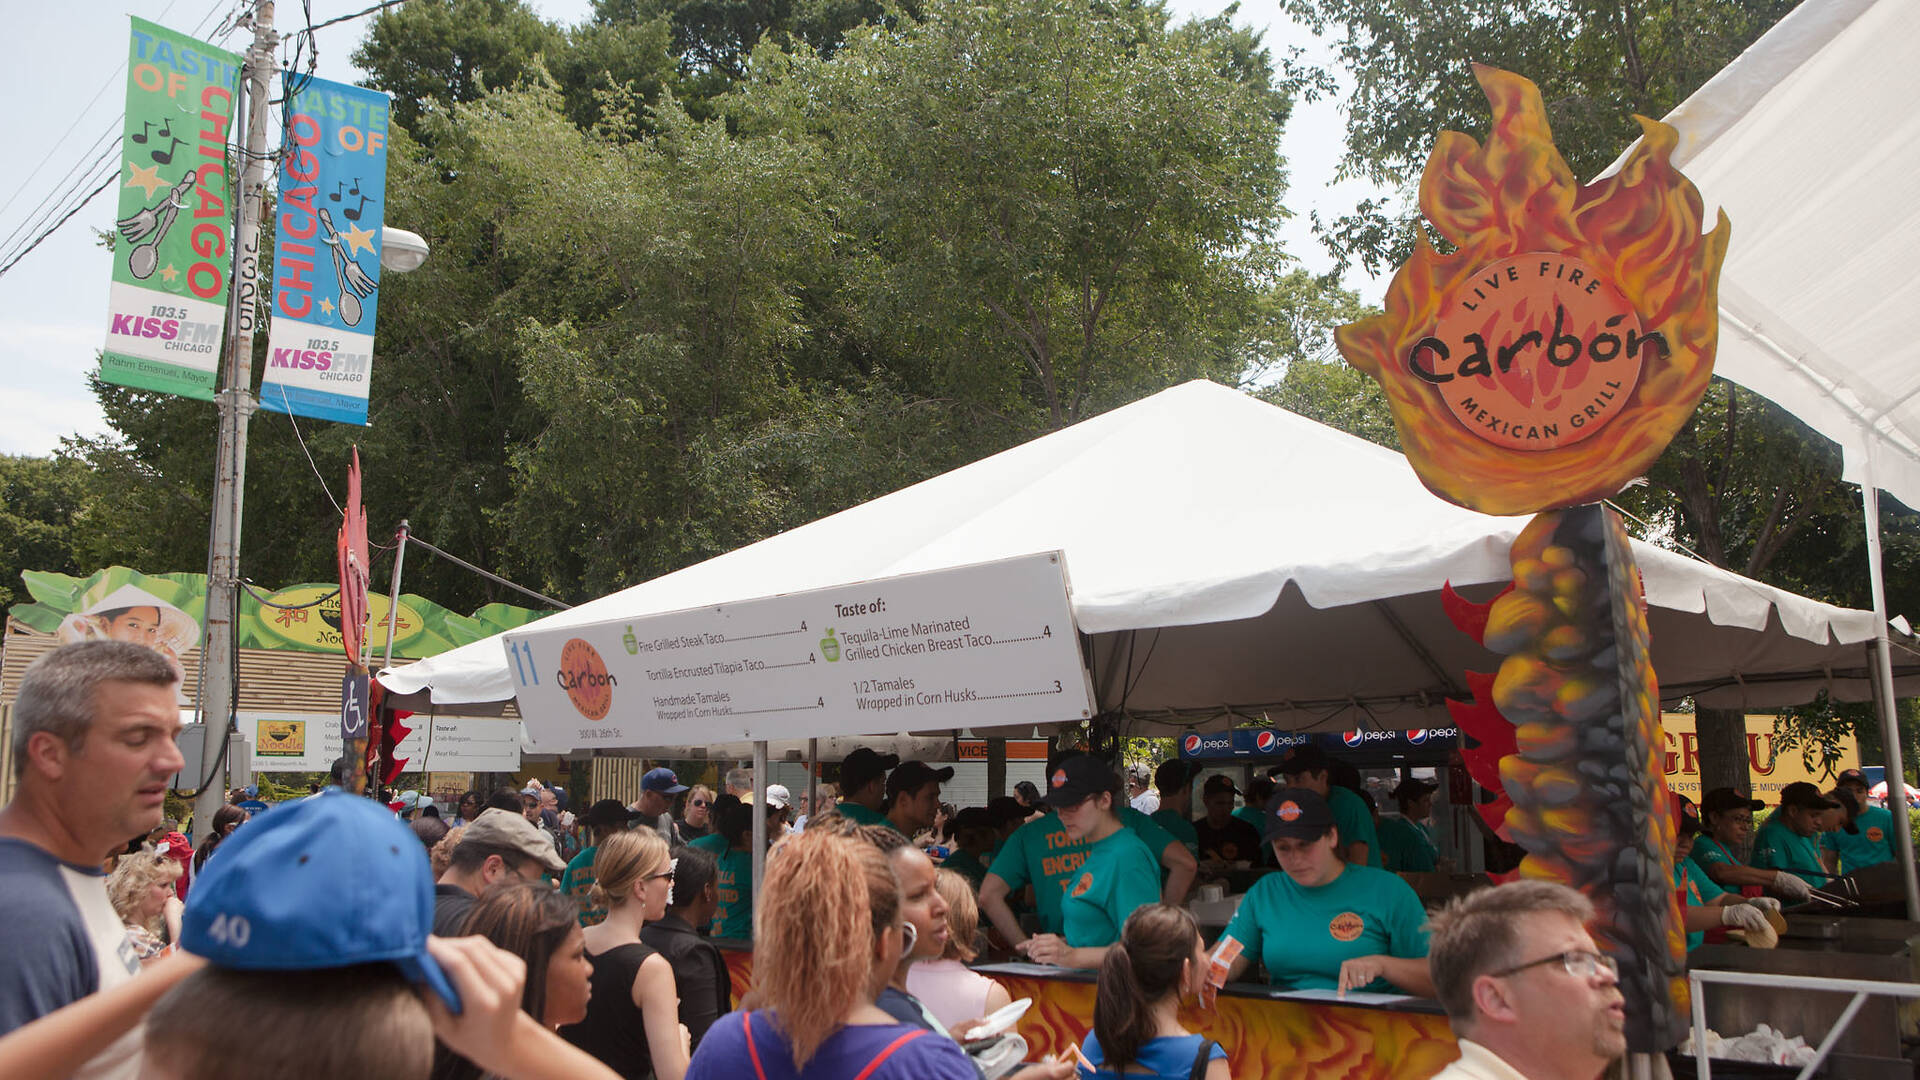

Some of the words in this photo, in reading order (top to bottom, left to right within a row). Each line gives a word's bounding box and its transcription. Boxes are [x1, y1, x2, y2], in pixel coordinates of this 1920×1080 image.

[133, 63, 187, 99] OF
[338, 126, 384, 156] OF
[187, 86, 231, 298] CHICAGO
[278, 113, 321, 318] CHICAGO
[240, 232, 259, 331] J325
[1462, 266, 1519, 311] LIVE
[1539, 261, 1601, 295] FIRE
[151, 305, 188, 320] 103.5
[164, 341, 212, 354] CHICAGO
[307, 339, 339, 351] 103.5
[108, 355, 136, 369] Rahm
[182, 370, 208, 384] Mayor
[320, 372, 363, 382] CHICAGO
[1460, 397, 1559, 440] MEXICAN
[1570, 378, 1621, 428] GRILL
[835, 602, 866, 618] Taste
[869, 598, 886, 613] of:
[639, 641, 654, 653] Fire
[654, 637, 679, 651] Grilled
[681, 635, 703, 649] Steak
[703, 632, 725, 645] Taco
[800, 621, 807, 632] 4
[840, 626, 909, 646] Tequila-Lime
[911, 616, 970, 637] Marinated
[845, 643, 880, 661] Grilled
[881, 641, 926, 657] Chicken
[927, 637, 964, 653] Breast
[964, 634, 993, 648] Taco
[1043, 625, 1051, 638] 4
[511, 640, 539, 686] 11
[646, 667, 673, 681] Tortilla
[674, 663, 714, 679] Encrusted
[714, 661, 743, 676] Tilapia
[743, 659, 765, 672] Taco
[809, 652, 816, 664] 4
[653, 693, 696, 708] Handmade
[696, 690, 731, 705] Tamales
[853, 680, 870, 694] 1/2
[871, 677, 915, 692] Tamales
[857, 694, 902, 712] Wrapped
[904, 694, 914, 706] in
[916, 692, 942, 706] Corn
[944, 688, 977, 702] Husks
[1054, 680, 1062, 693] 3
[694, 707, 711, 718] Corn
[712, 705, 733, 717] Husks
[818, 696, 825, 708] 4
[1276, 734, 1306, 747] pepsi
[209, 912, 250, 948] 40
